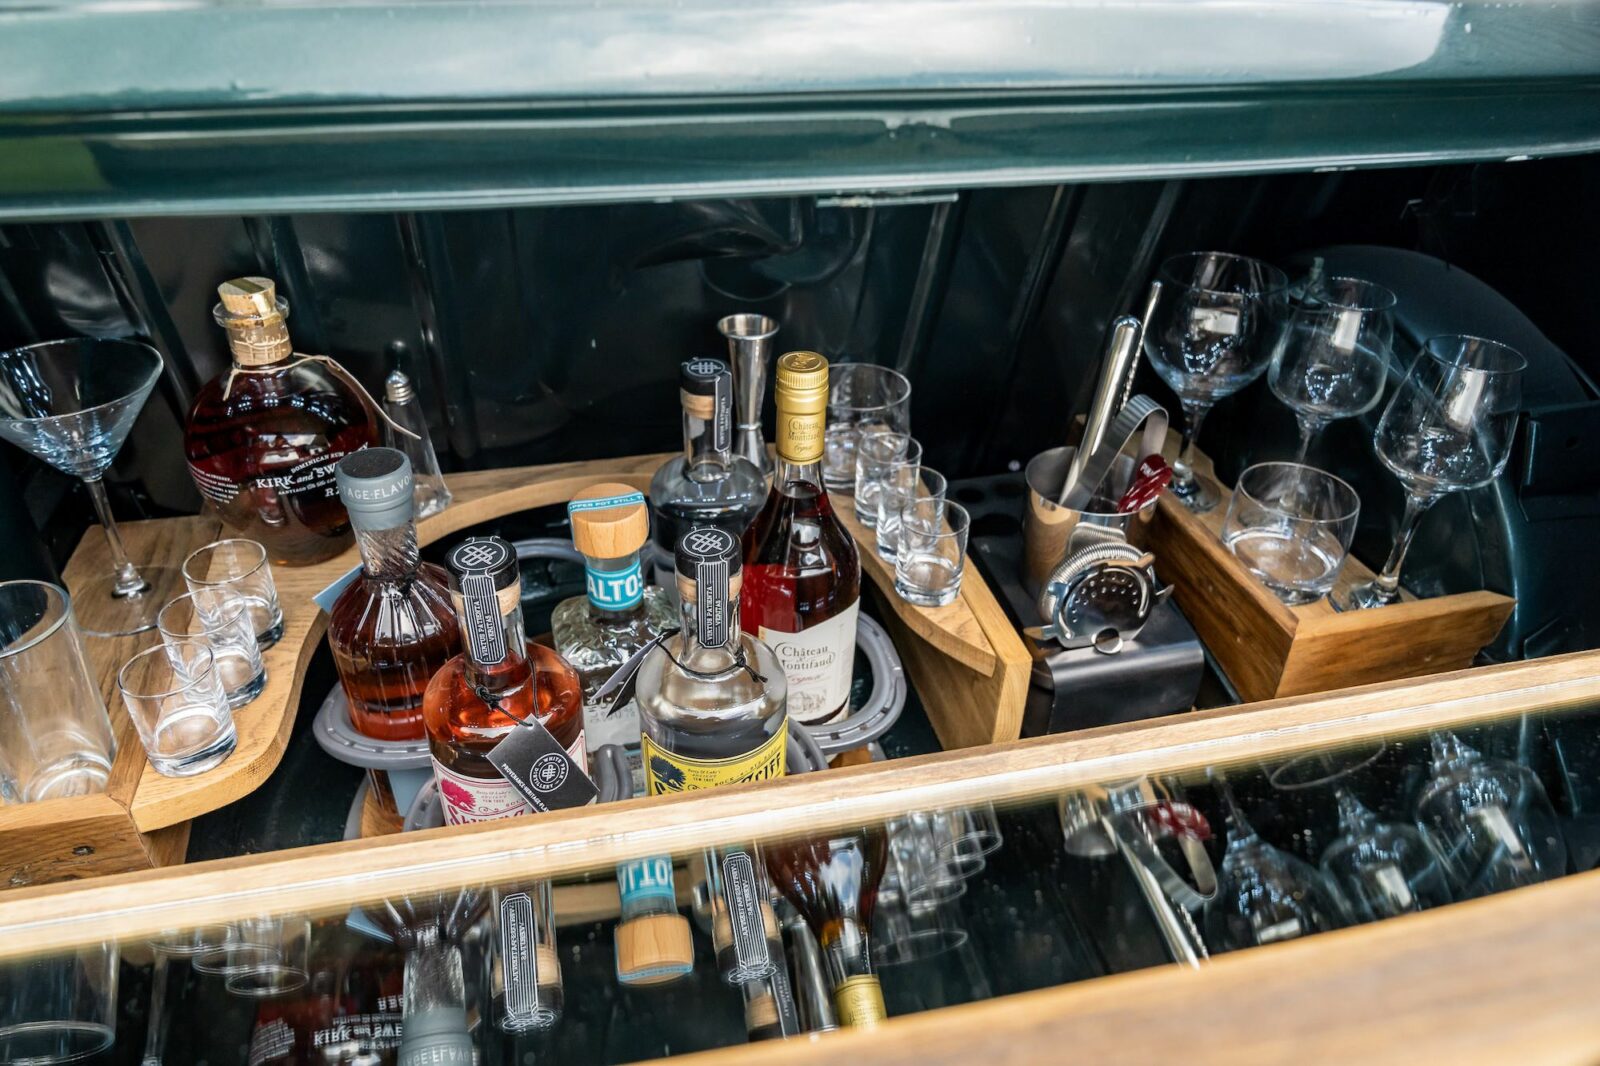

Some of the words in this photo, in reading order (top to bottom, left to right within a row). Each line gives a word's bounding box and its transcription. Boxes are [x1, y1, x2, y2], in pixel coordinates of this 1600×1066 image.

[290, 454, 330, 474] DOMINICAN
[330, 451, 345, 459] RUM
[255, 474, 296, 492] KIRK
[296, 471, 315, 484] and
[595, 500, 612, 508] POT
[613, 497, 637, 505] STILL
[782, 645, 829, 657] Château
[532, 767, 554, 790] DISTILLERY
[558, 763, 566, 780] PEAK
